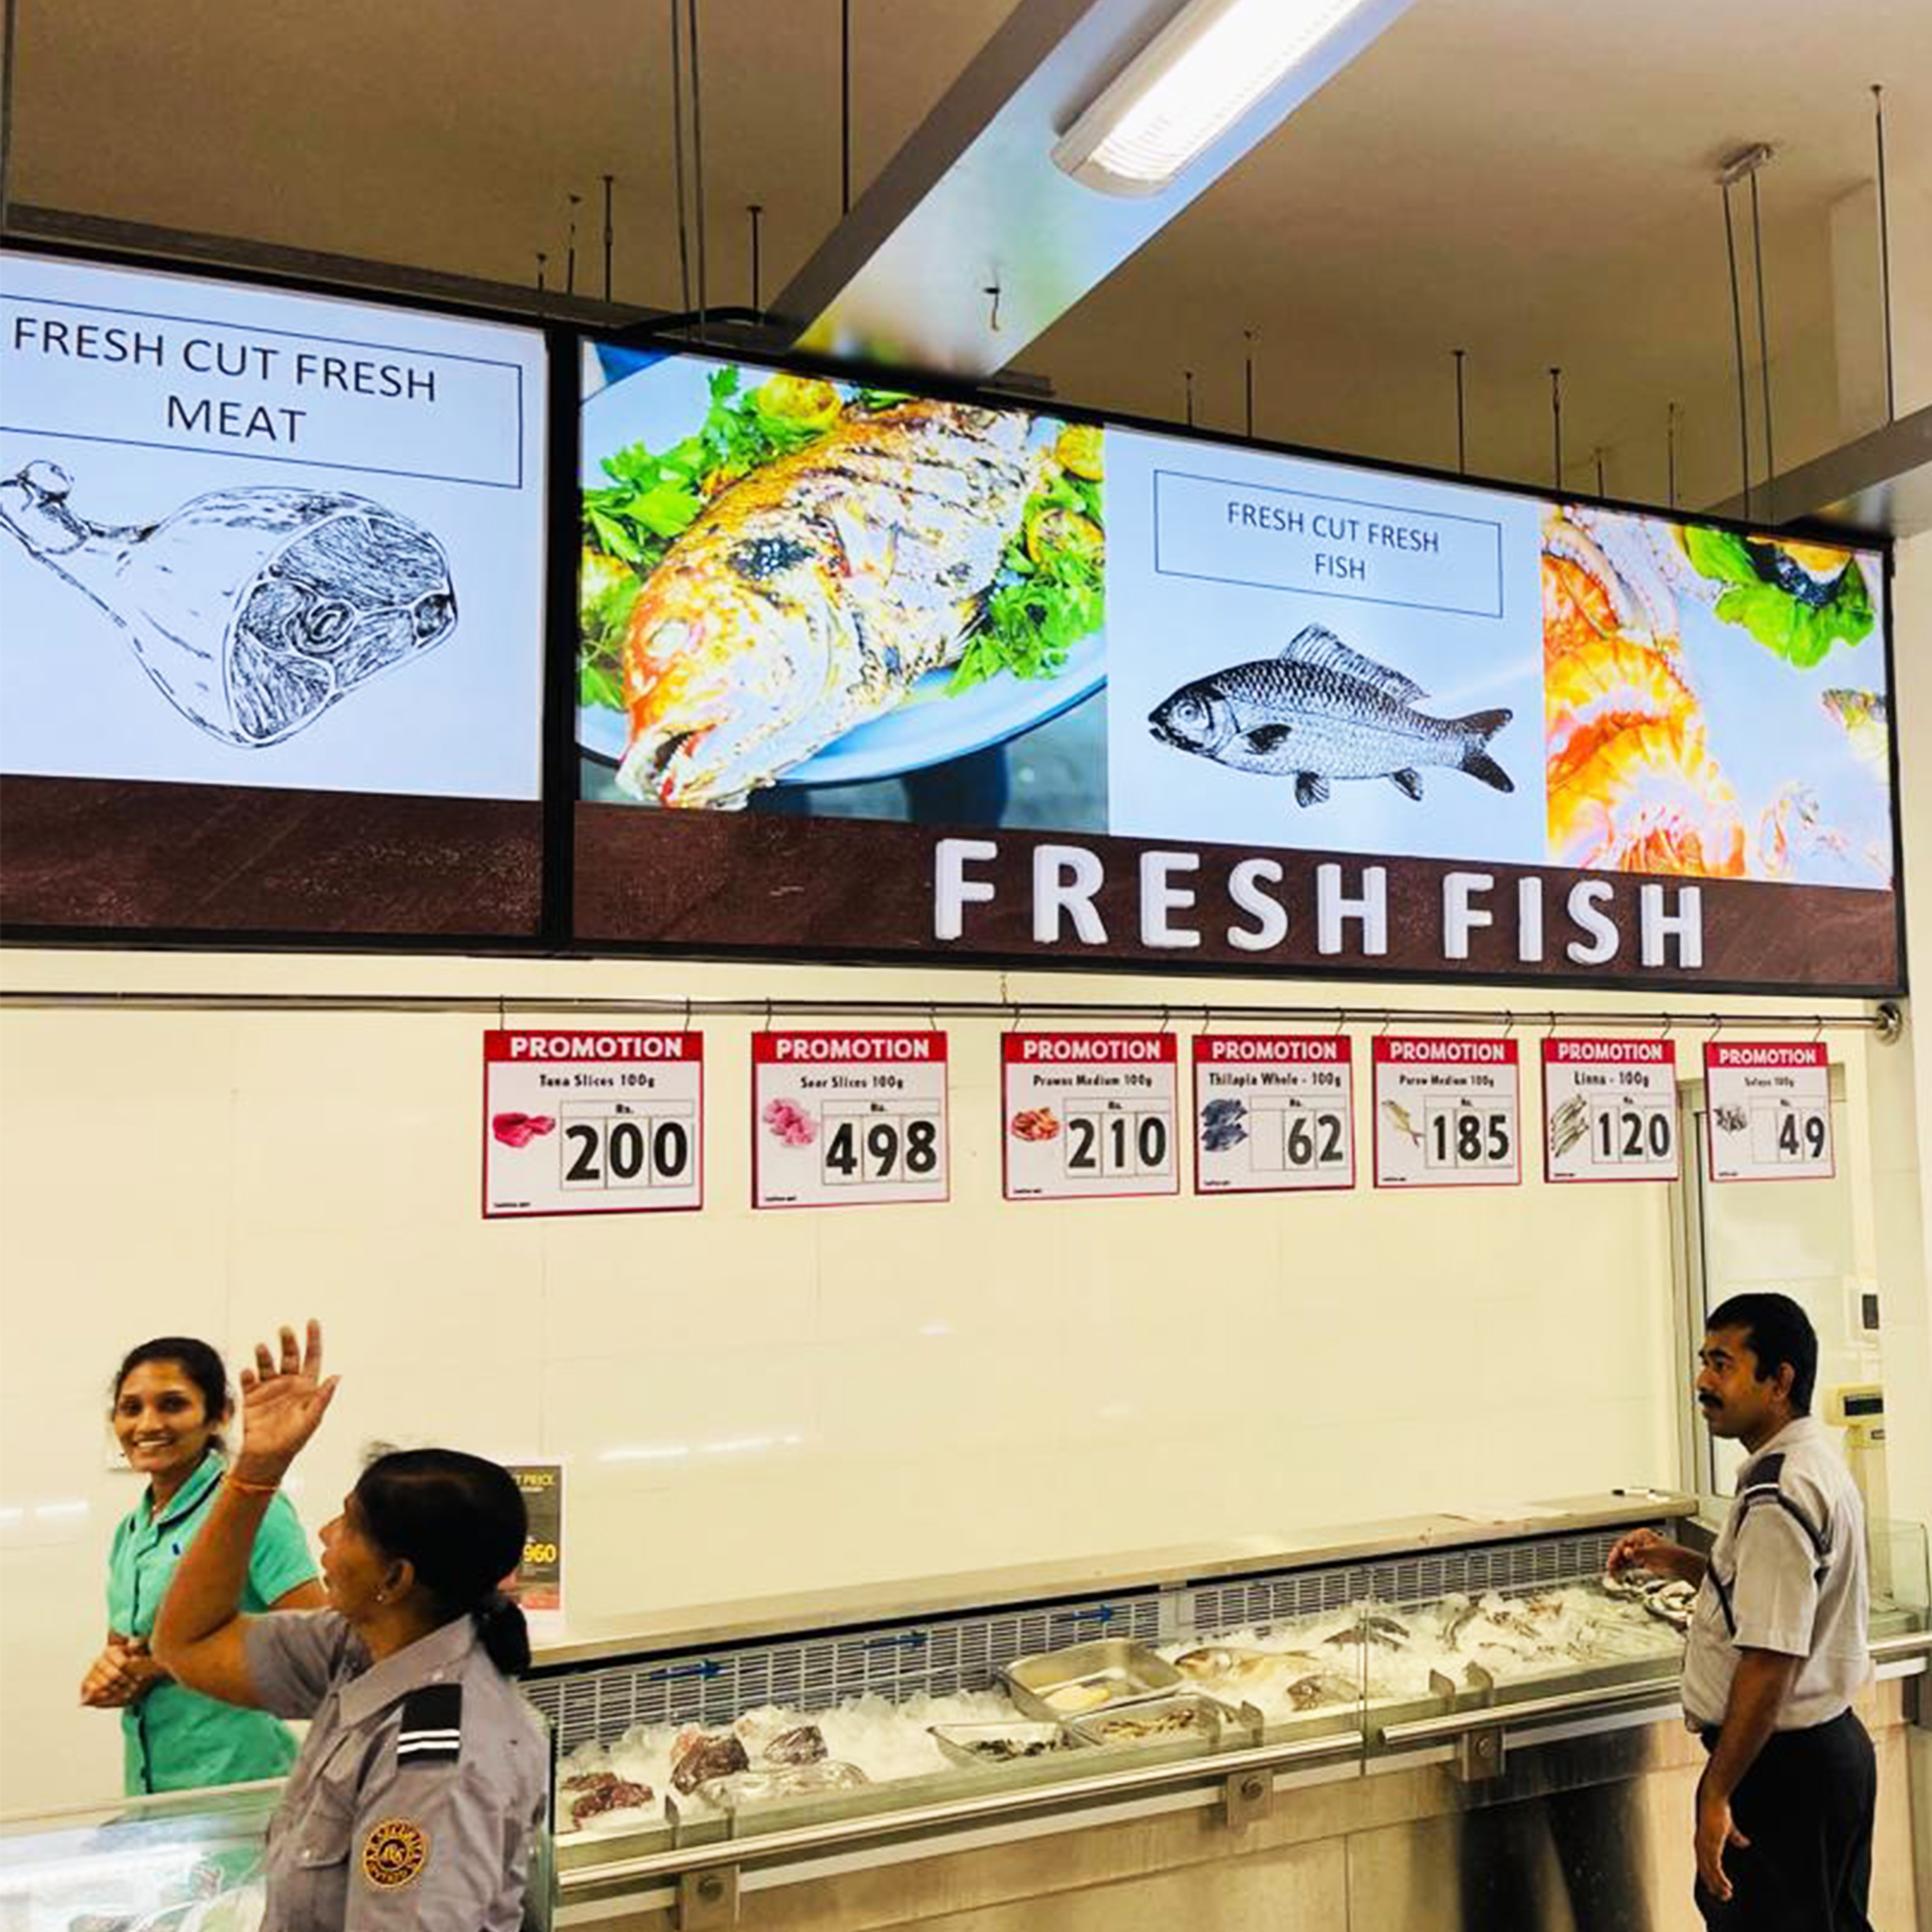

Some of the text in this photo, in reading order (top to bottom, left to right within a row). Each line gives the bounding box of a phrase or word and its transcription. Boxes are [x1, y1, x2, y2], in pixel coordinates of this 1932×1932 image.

[13, 317, 437, 403] FRESH CUT FRESH
[166, 393, 308, 443] MEAT
[1227, 501, 1439, 553] FRESH CUT FRESH
[1315, 553, 1366, 581] FISH
[933, 838, 1702, 969] FRESH FISH
[510, 1037, 683, 1058] PROMOTION
[775, 1039, 930, 1059] PROMOTION
[1024, 1040, 1160, 1059] PROMOTION
[1212, 1041, 1337, 1059] PROMOTION
[1391, 1041, 1505, 1060] PROMOTION
[1558, 1042, 1662, 1060] PROMOTION
[1720, 1049, 1816, 1064] PROMOTION
[574, 1074, 614, 1087] Slices
[621, 1074, 655, 1088] 100g
[831, 1075, 867, 1088] Slices
[873, 1075, 904, 1089] 100g
[1076, 1074, 1120, 1086] Medium
[1124, 1074, 1152, 1088] 100g
[1260, 1073, 1298, 1085] Whole
[1312, 1072, 1341, 1087] 100g
[1619, 1072, 1649, 1088] 100g
[1068, 1116, 1166, 1168] 210
[1288, 1114, 1343, 1165] 62
[1433, 1113, 1509, 1161] 185
[1598, 1112, 1671, 1157] 120
[1779, 1114, 1824, 1158] 49
[565, 1123, 688, 1181] 200
[825, 1120, 937, 1176] 498
